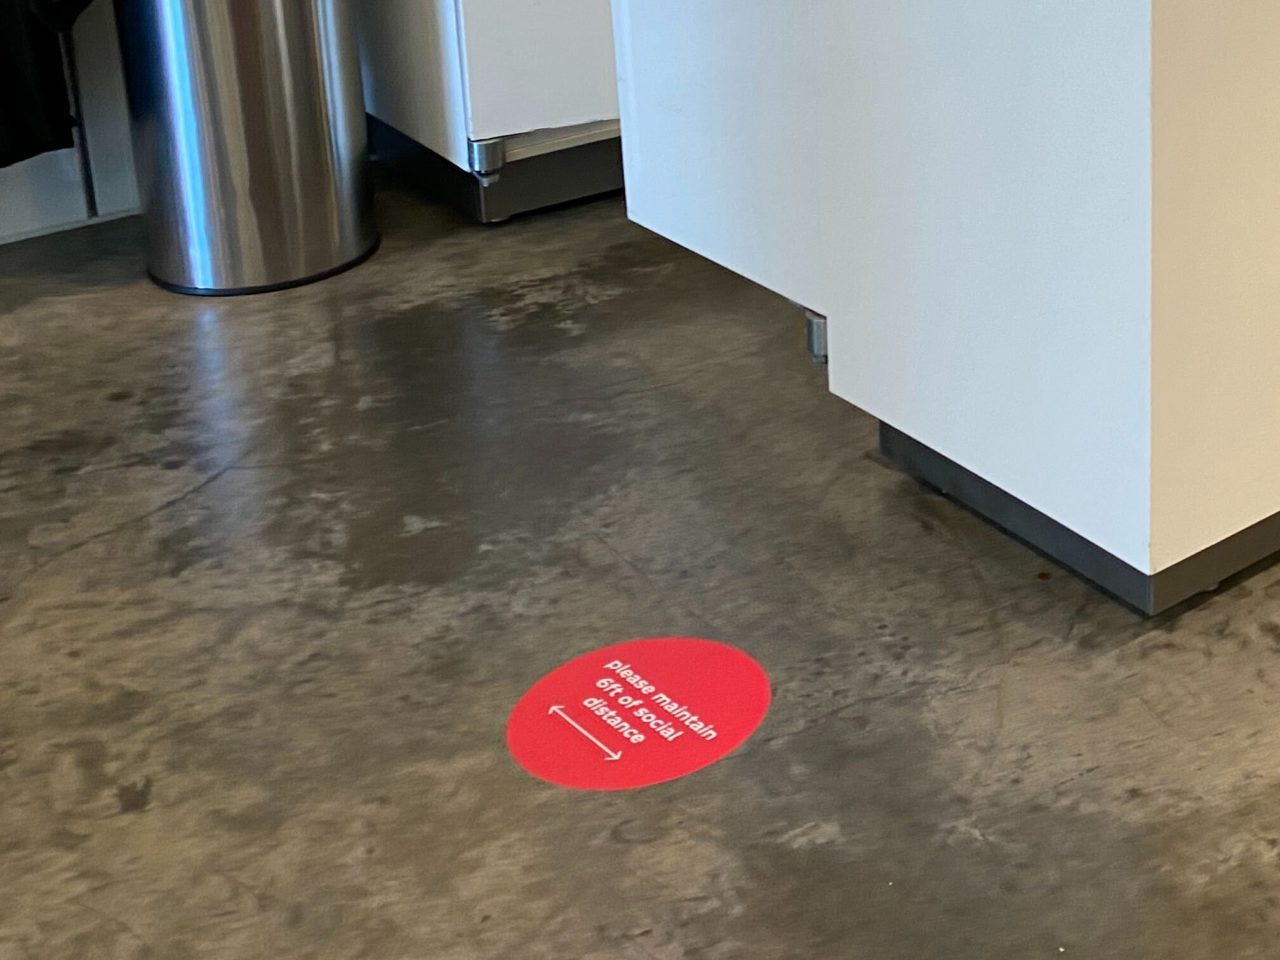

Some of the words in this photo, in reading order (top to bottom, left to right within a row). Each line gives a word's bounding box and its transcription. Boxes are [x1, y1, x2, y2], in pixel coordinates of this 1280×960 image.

[582, 697, 646, 744] distance
[595, 678, 624, 697] 6ft
[618, 695, 643, 710] of
[633, 707, 683, 742] social
[603, 659, 656, 694] please
[652, 692, 718, 741] maintain
